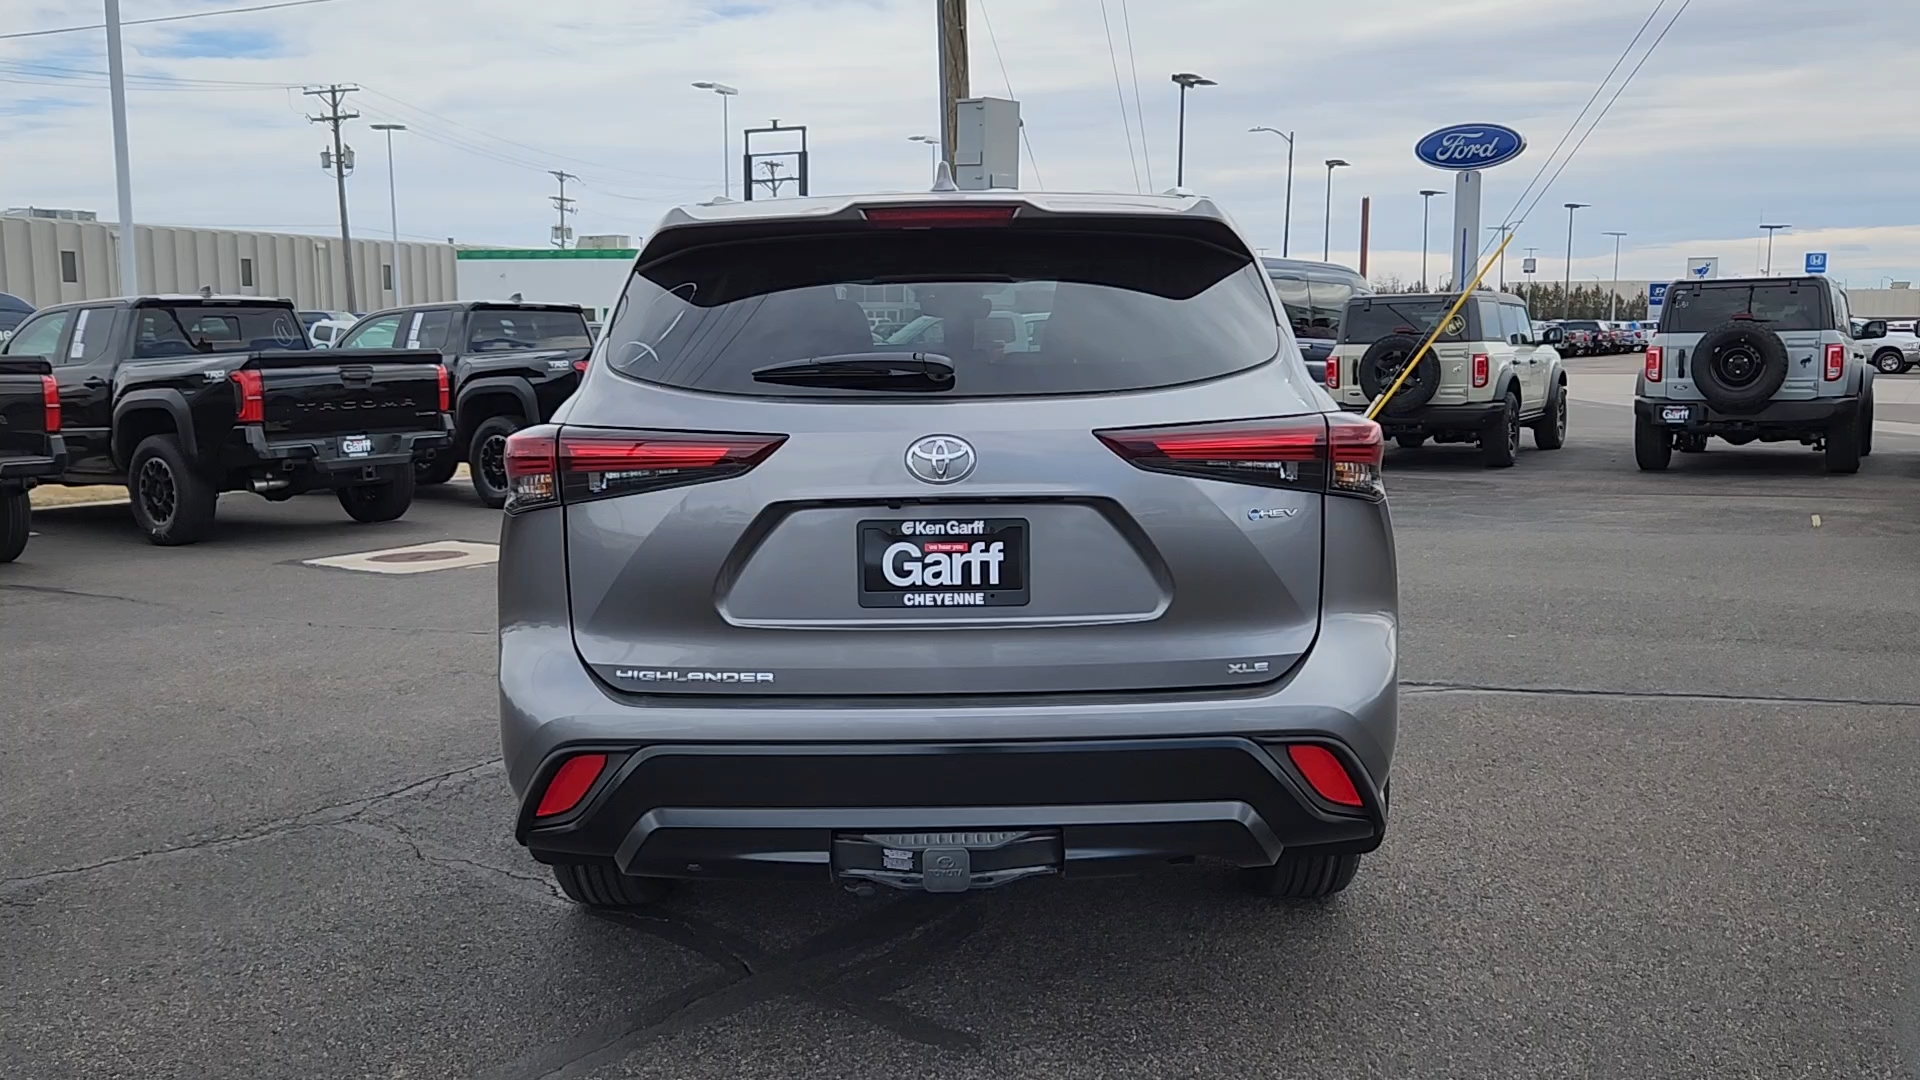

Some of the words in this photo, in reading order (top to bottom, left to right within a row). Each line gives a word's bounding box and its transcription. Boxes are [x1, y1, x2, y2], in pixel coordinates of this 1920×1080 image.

[1436, 132, 1499, 160] Ford
[203, 370, 225, 379] TRD
[297, 399, 416, 411] TACOMA
[1662, 409, 1689, 420] Garff
[343, 440, 371, 453] Garff
[915, 520, 945, 535] Ken
[946, 520, 985, 535] Garff
[882, 541, 1004, 587] Garff
[903, 592, 985, 606] CHEYENNE
[1228, 661, 1269, 674] XLE
[615, 669, 775, 683] HIGHLANDER
